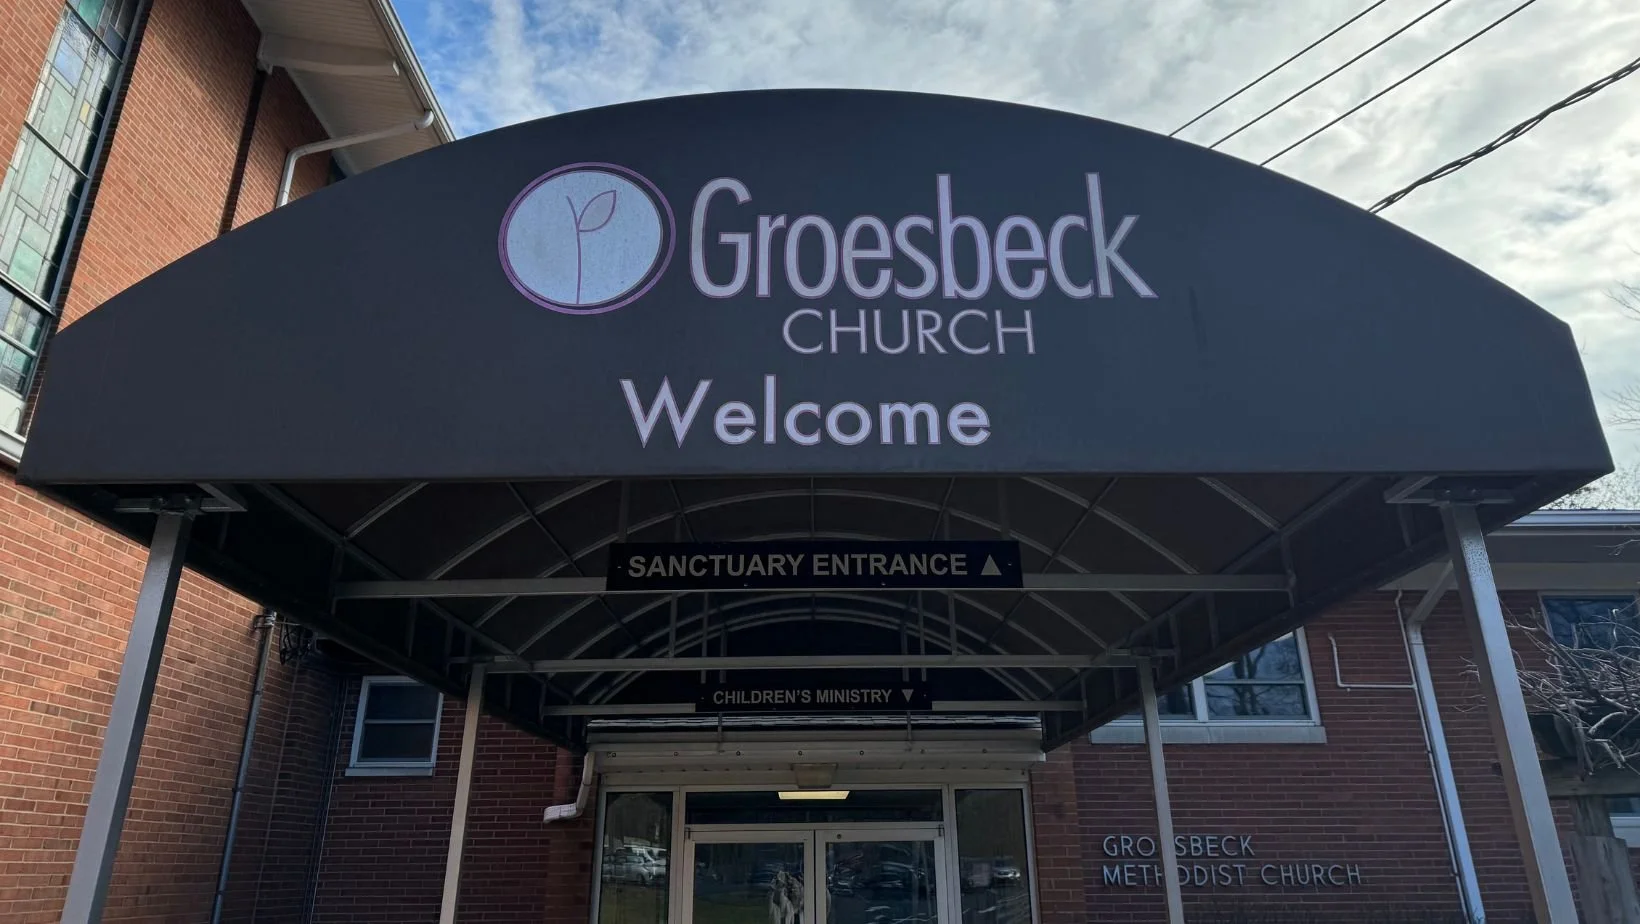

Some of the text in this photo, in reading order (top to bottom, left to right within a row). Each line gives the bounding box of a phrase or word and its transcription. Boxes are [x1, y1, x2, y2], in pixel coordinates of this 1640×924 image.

[690, 173, 1158, 299] Groesbeck
[783, 308, 1036, 355] CHURCH
[620, 374, 992, 448] Welcome
[628, 553, 968, 578] SANCTUARY ENTRANCE
[713, 688, 893, 705] CHILDREN'S MINISTRY
[1103, 835, 1255, 857] GROSBECK
[1260, 863, 1363, 886] CHURCH
